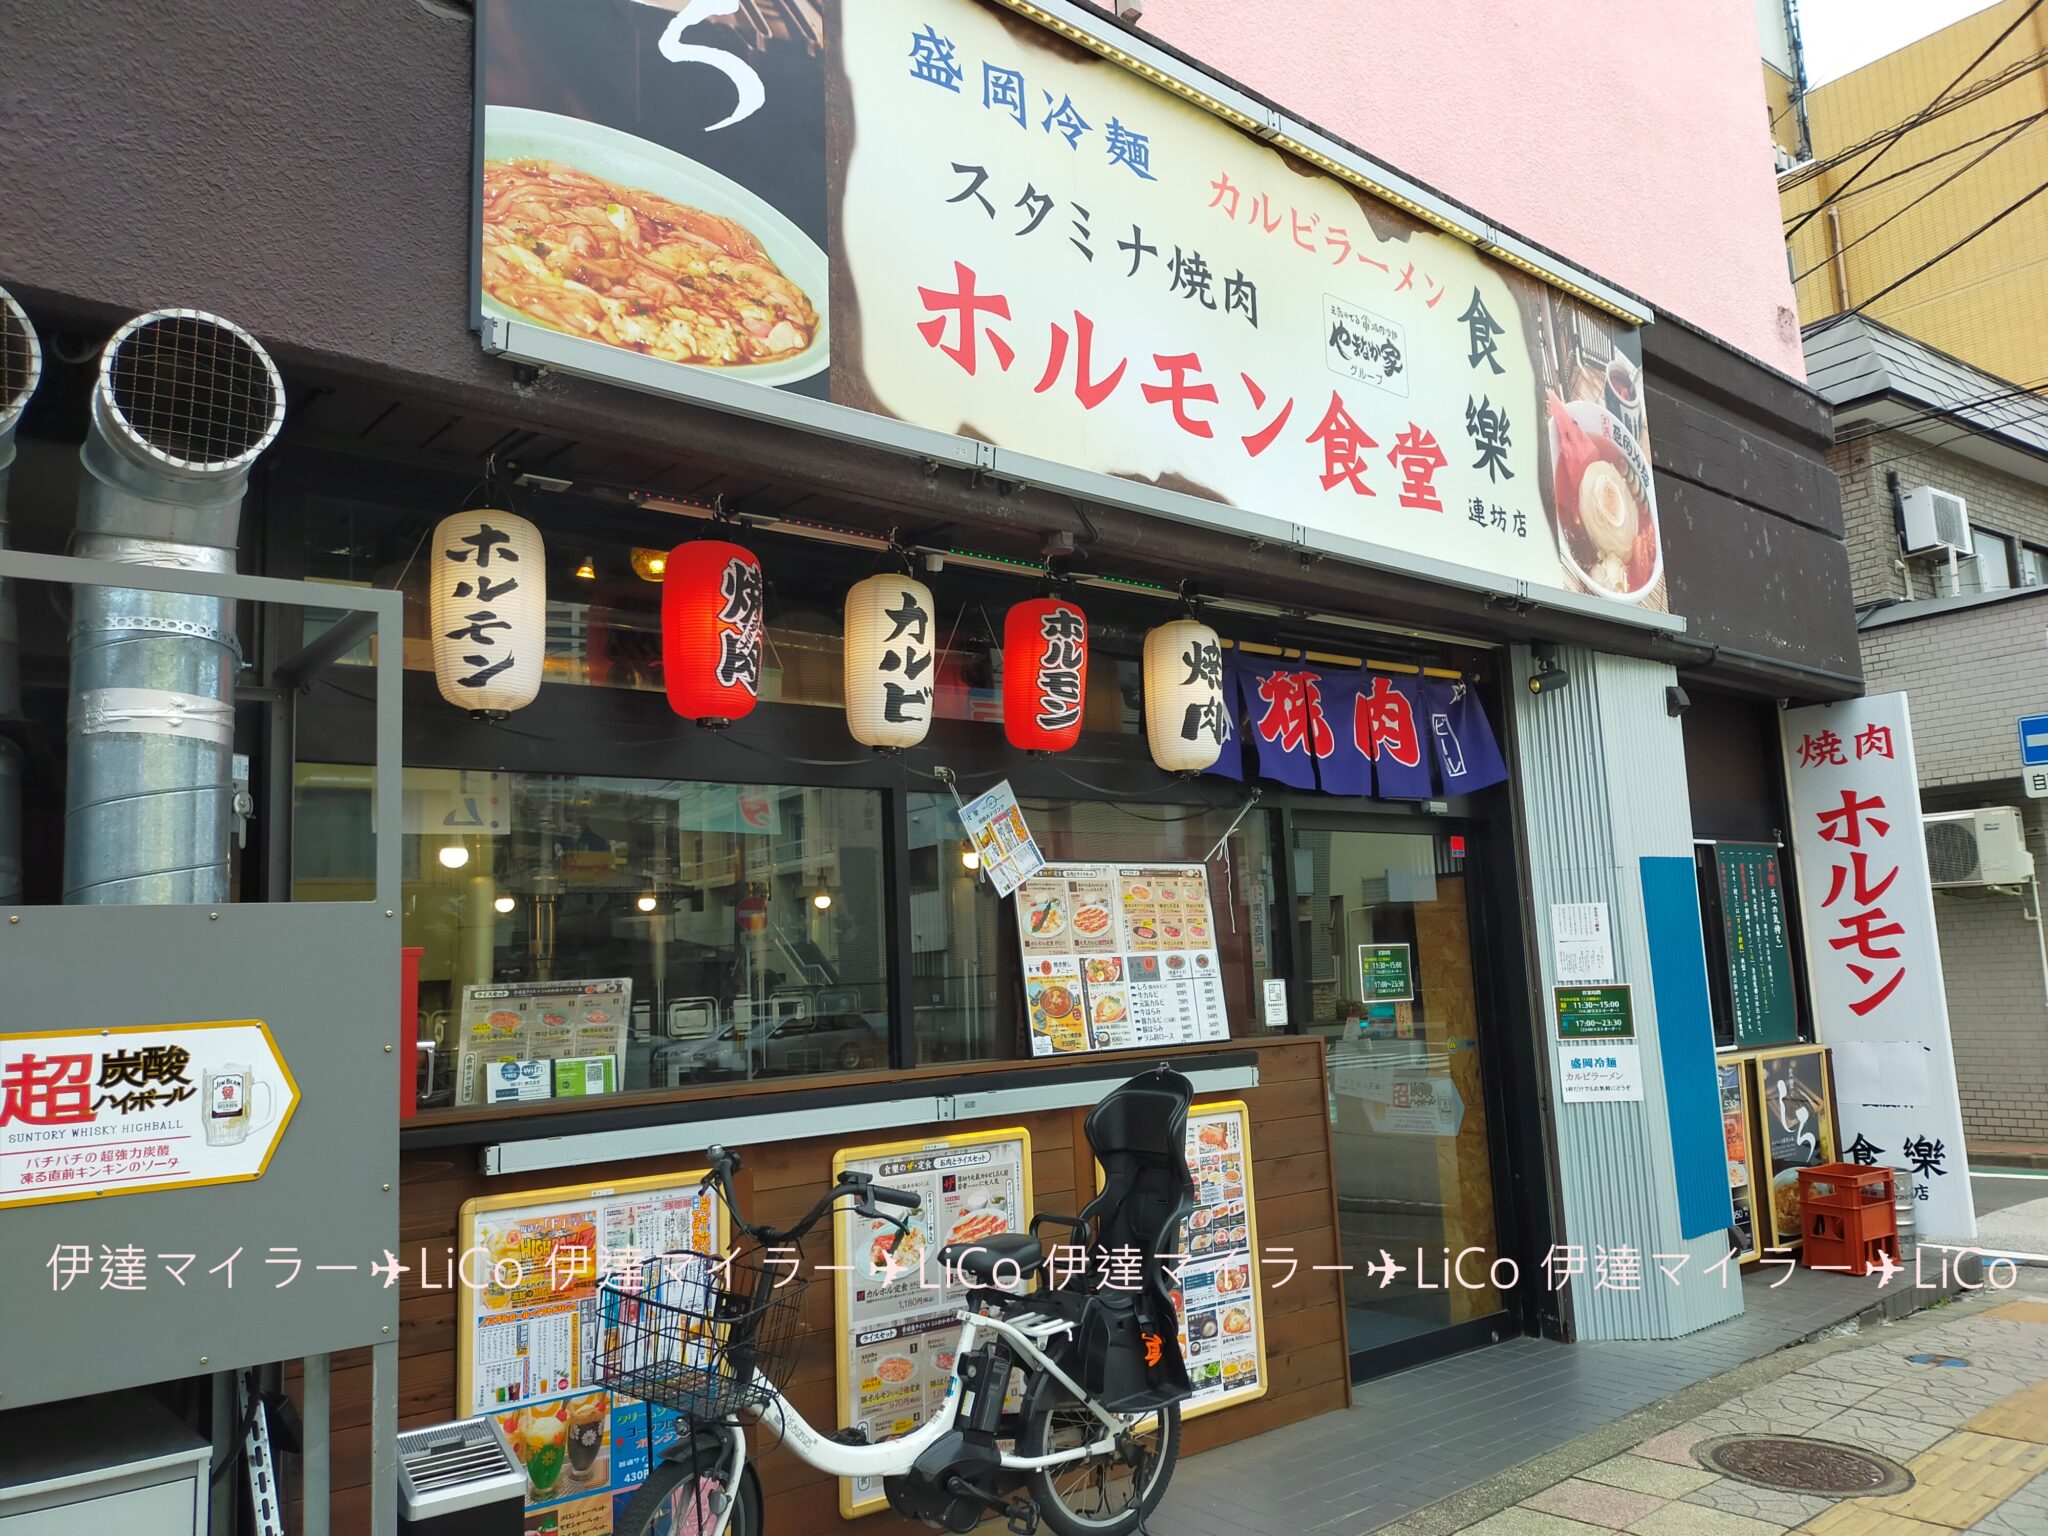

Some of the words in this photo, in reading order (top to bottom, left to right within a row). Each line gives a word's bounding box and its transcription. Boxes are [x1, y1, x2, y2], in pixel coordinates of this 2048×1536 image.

[945, 162, 1259, 330] スタミナ焼肉
[1208, 171, 1445, 309] カルビラーメン
[1329, 319, 1403, 377] やまなか家
[1350, 364, 1383, 385] グループ
[916, 260, 1450, 514] ホルモン食堂
[1468, 498, 1528, 538] 連坊店
[445, 523, 520, 689] ホルモン
[715, 557, 764, 697] 焼肉
[879, 591, 934, 725] カルビ
[1036, 607, 1089, 731] ホルモン
[1182, 637, 1223, 746] 焼肉
[1257, 671, 1421, 767] 焼肉
[1433, 716, 1462, 775] ビール
[1797, 723, 1895, 769] 焼肉
[1818, 790, 1905, 1017] ホルモン
[0, 1053, 98, 1128] 超
[96, 1045, 193, 1088] 炭酸
[1565, 1072, 1624, 1081] カルビラーメン
[91, 1086, 198, 1115] ハイボール
[8, 1126, 66, 1144] SUNTORY
[72, 1124, 118, 1139] WHISKY
[122, 1120, 184, 1134] HIGHBALL
[26, 1144, 170, 1169] パチパチの超強力炭酸
[866, 1283, 908, 1299] カルホル定食
[862, 1331, 895, 1342] ライスセット
